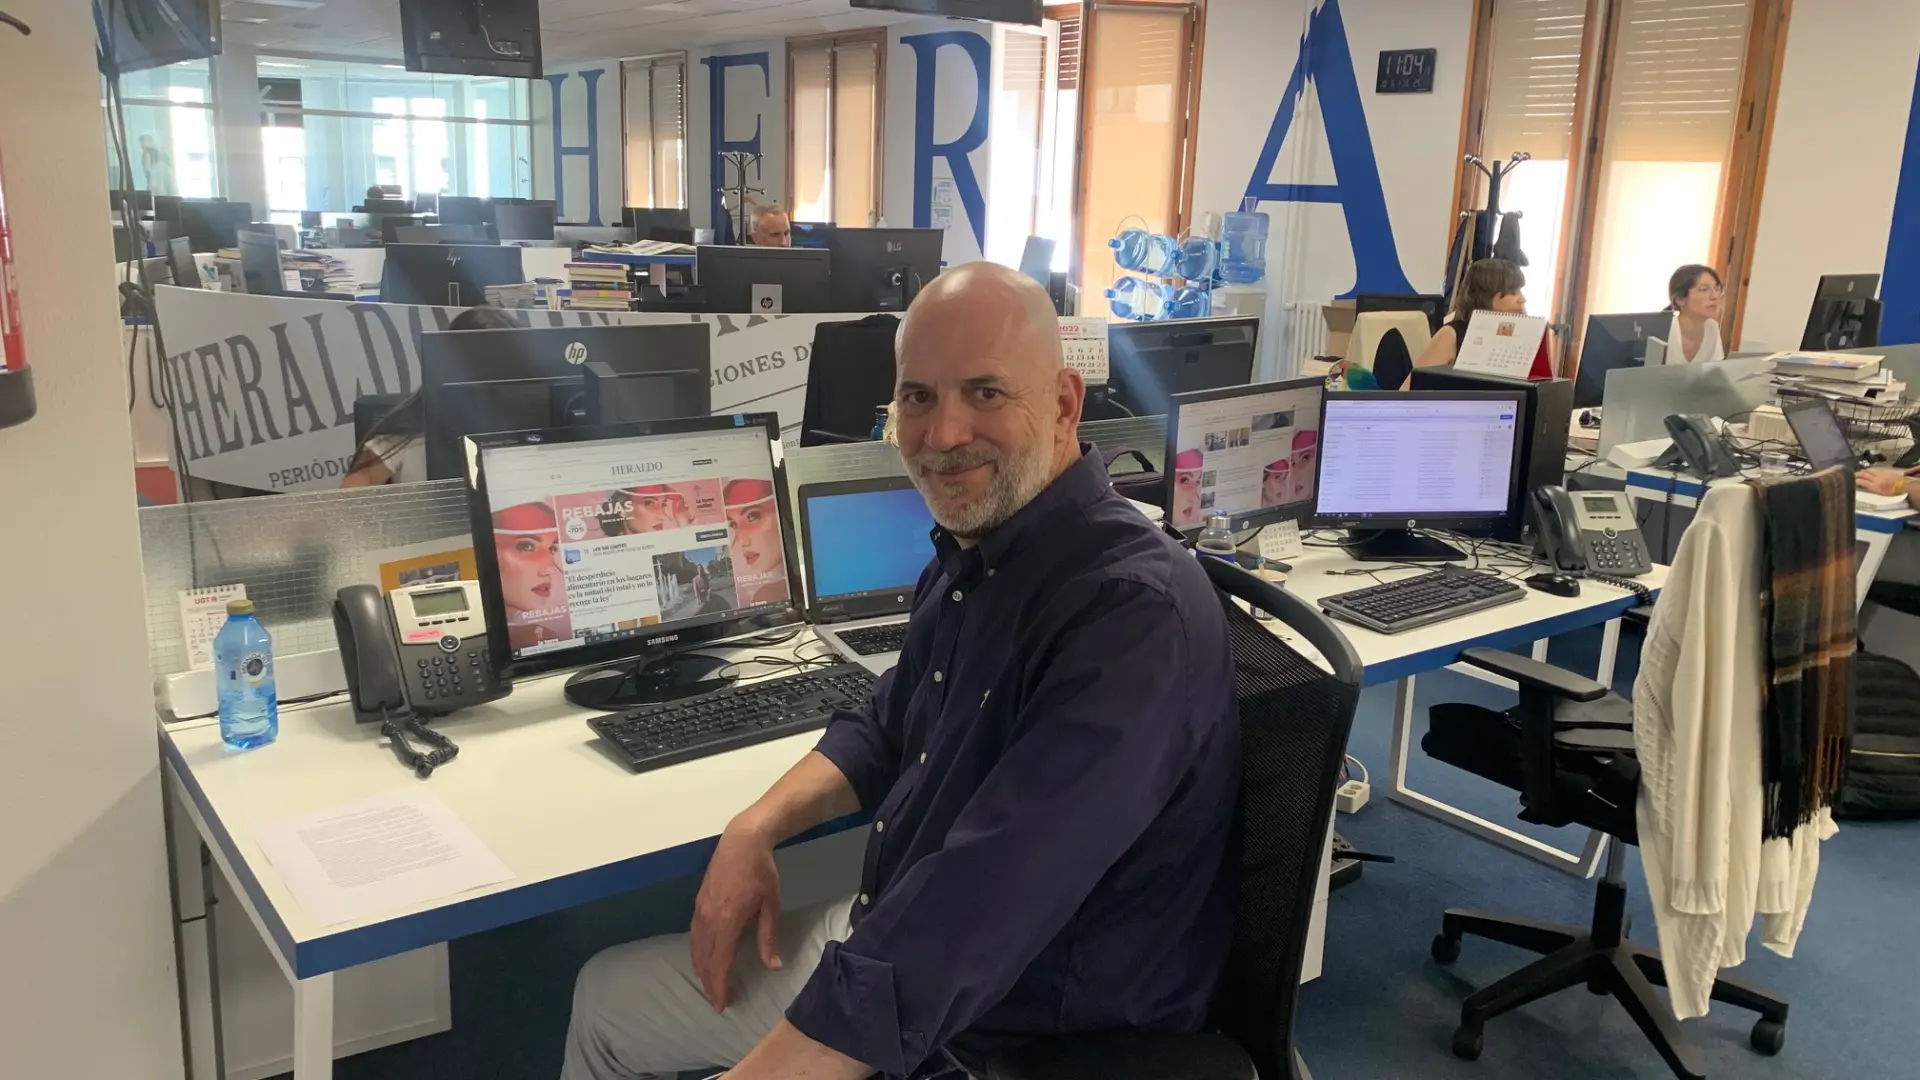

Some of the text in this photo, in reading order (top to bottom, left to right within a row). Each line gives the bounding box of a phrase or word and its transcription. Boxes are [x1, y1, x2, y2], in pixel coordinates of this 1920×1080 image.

[1386, 54, 1425, 75] 11:04
[567, 342, 586, 364] hp
[611, 461, 663, 476] HERALDO
[562, 500, 634, 521] REBAJAS
[567, 525, 585, 534] -70%
[194, 596, 210, 605] UGT
[521, 605, 568, 620] REBAJAS
[646, 634, 679, 646] SAMSUNG
